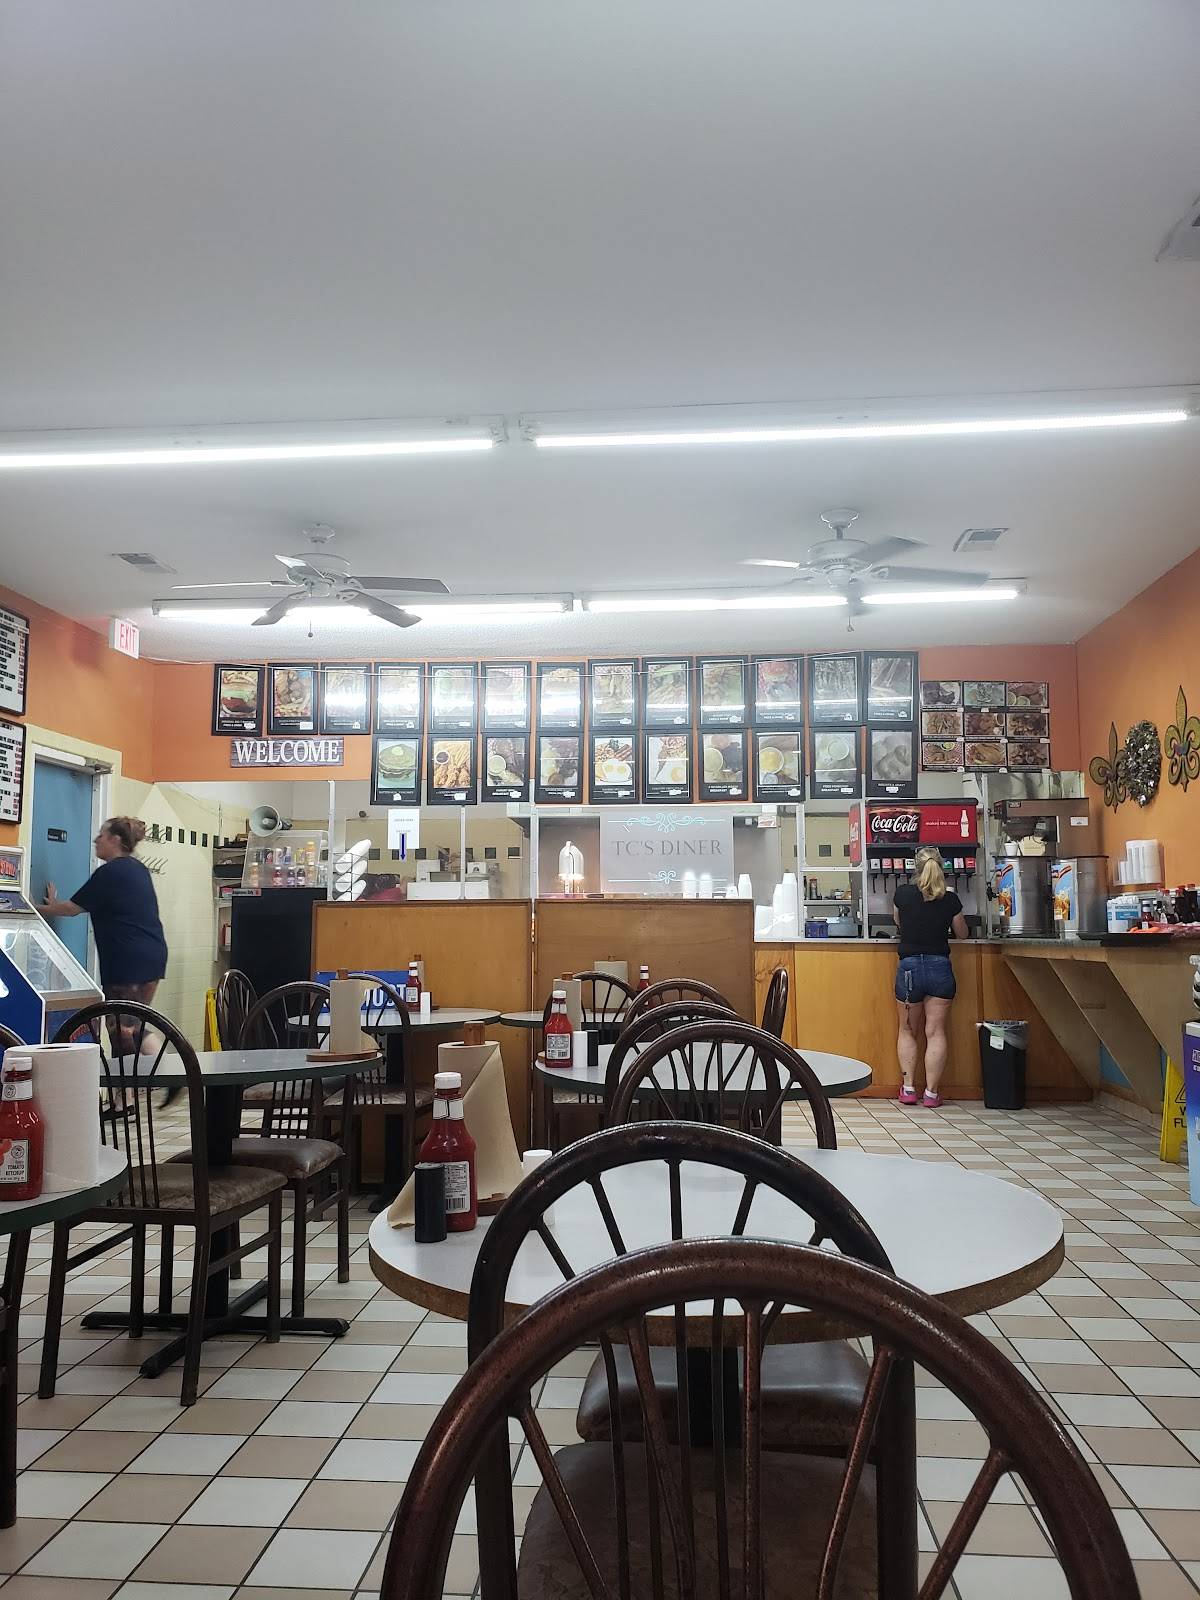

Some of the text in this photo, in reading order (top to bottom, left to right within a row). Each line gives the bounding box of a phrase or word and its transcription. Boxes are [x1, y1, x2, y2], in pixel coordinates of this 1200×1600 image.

[119, 622, 137, 653] EXIT
[234, 740, 340, 763] WELCOME
[871, 814, 919, 833] Coca-Cola
[611, 839, 722, 856] TC'S DINER
